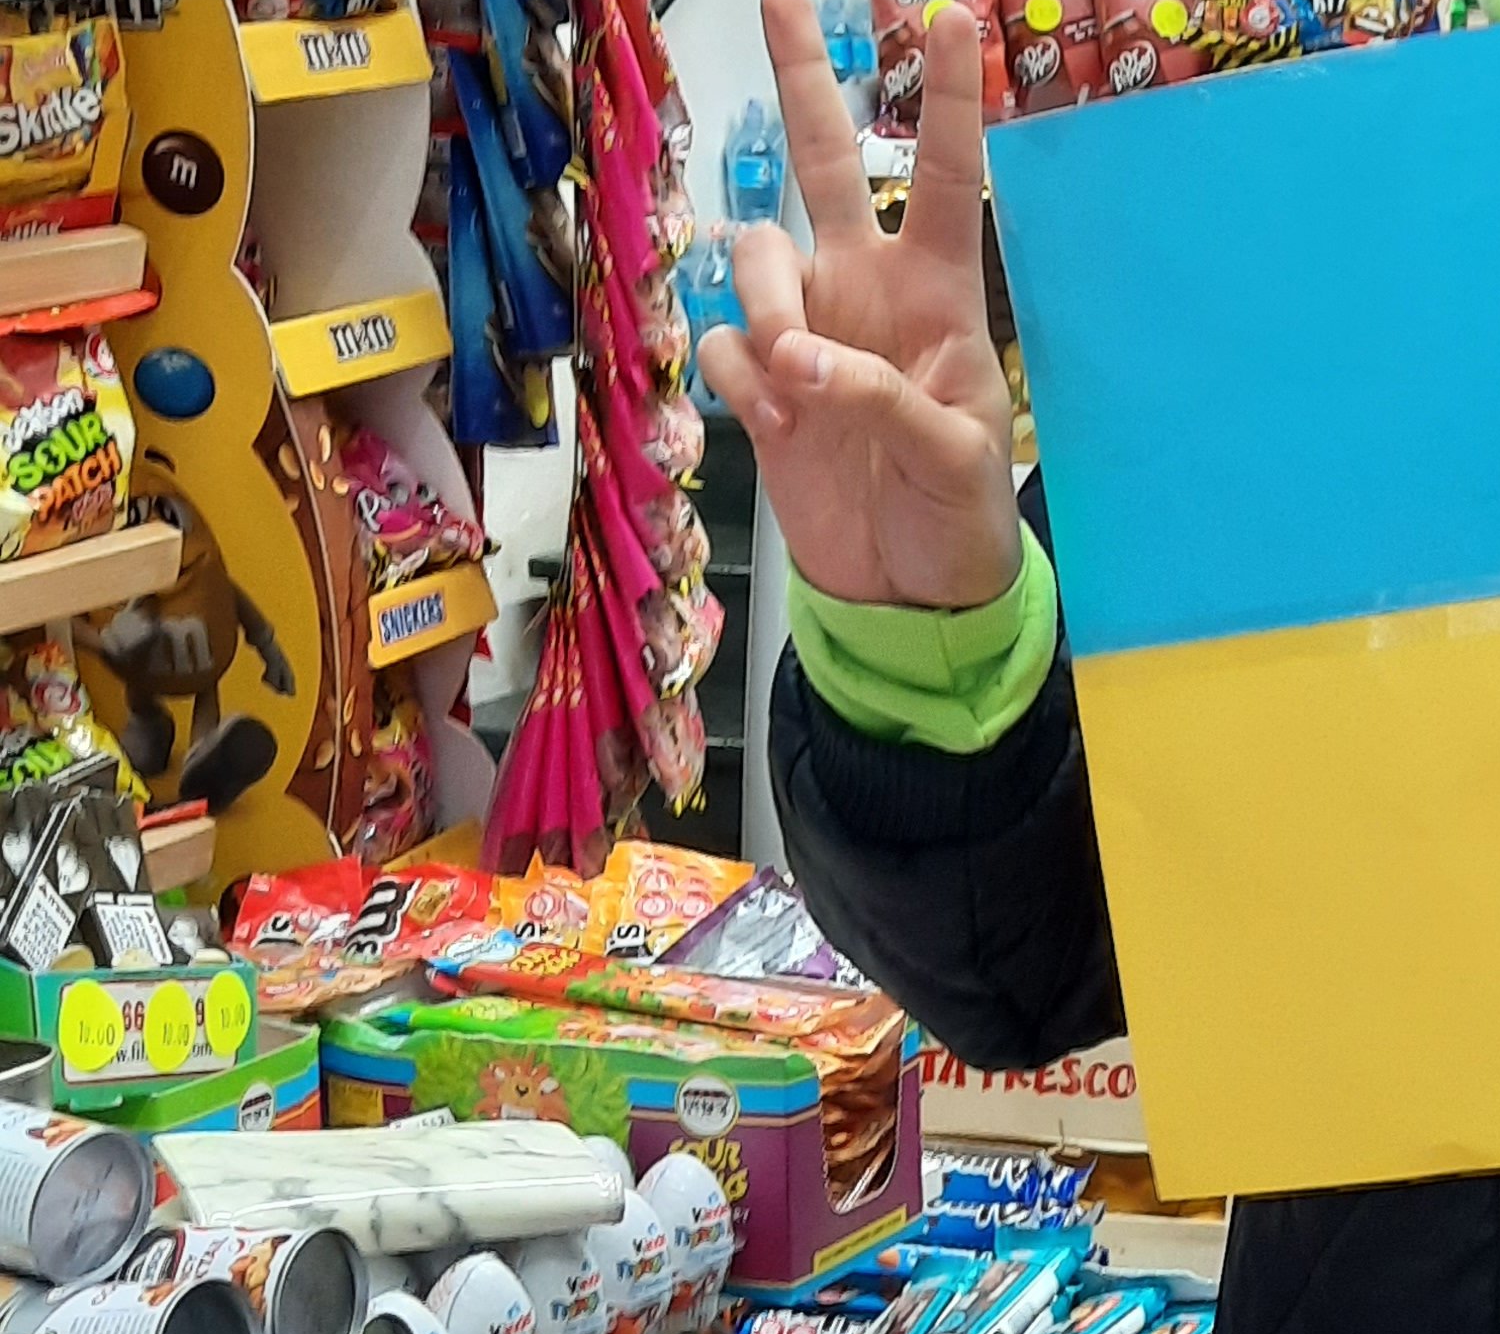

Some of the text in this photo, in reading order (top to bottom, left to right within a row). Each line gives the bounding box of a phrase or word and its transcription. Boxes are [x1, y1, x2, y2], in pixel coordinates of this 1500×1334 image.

[0, 83, 102, 156] Skittle
[10, 410, 107, 494] SOUR
[381, 594, 445, 642] SNICKERS
